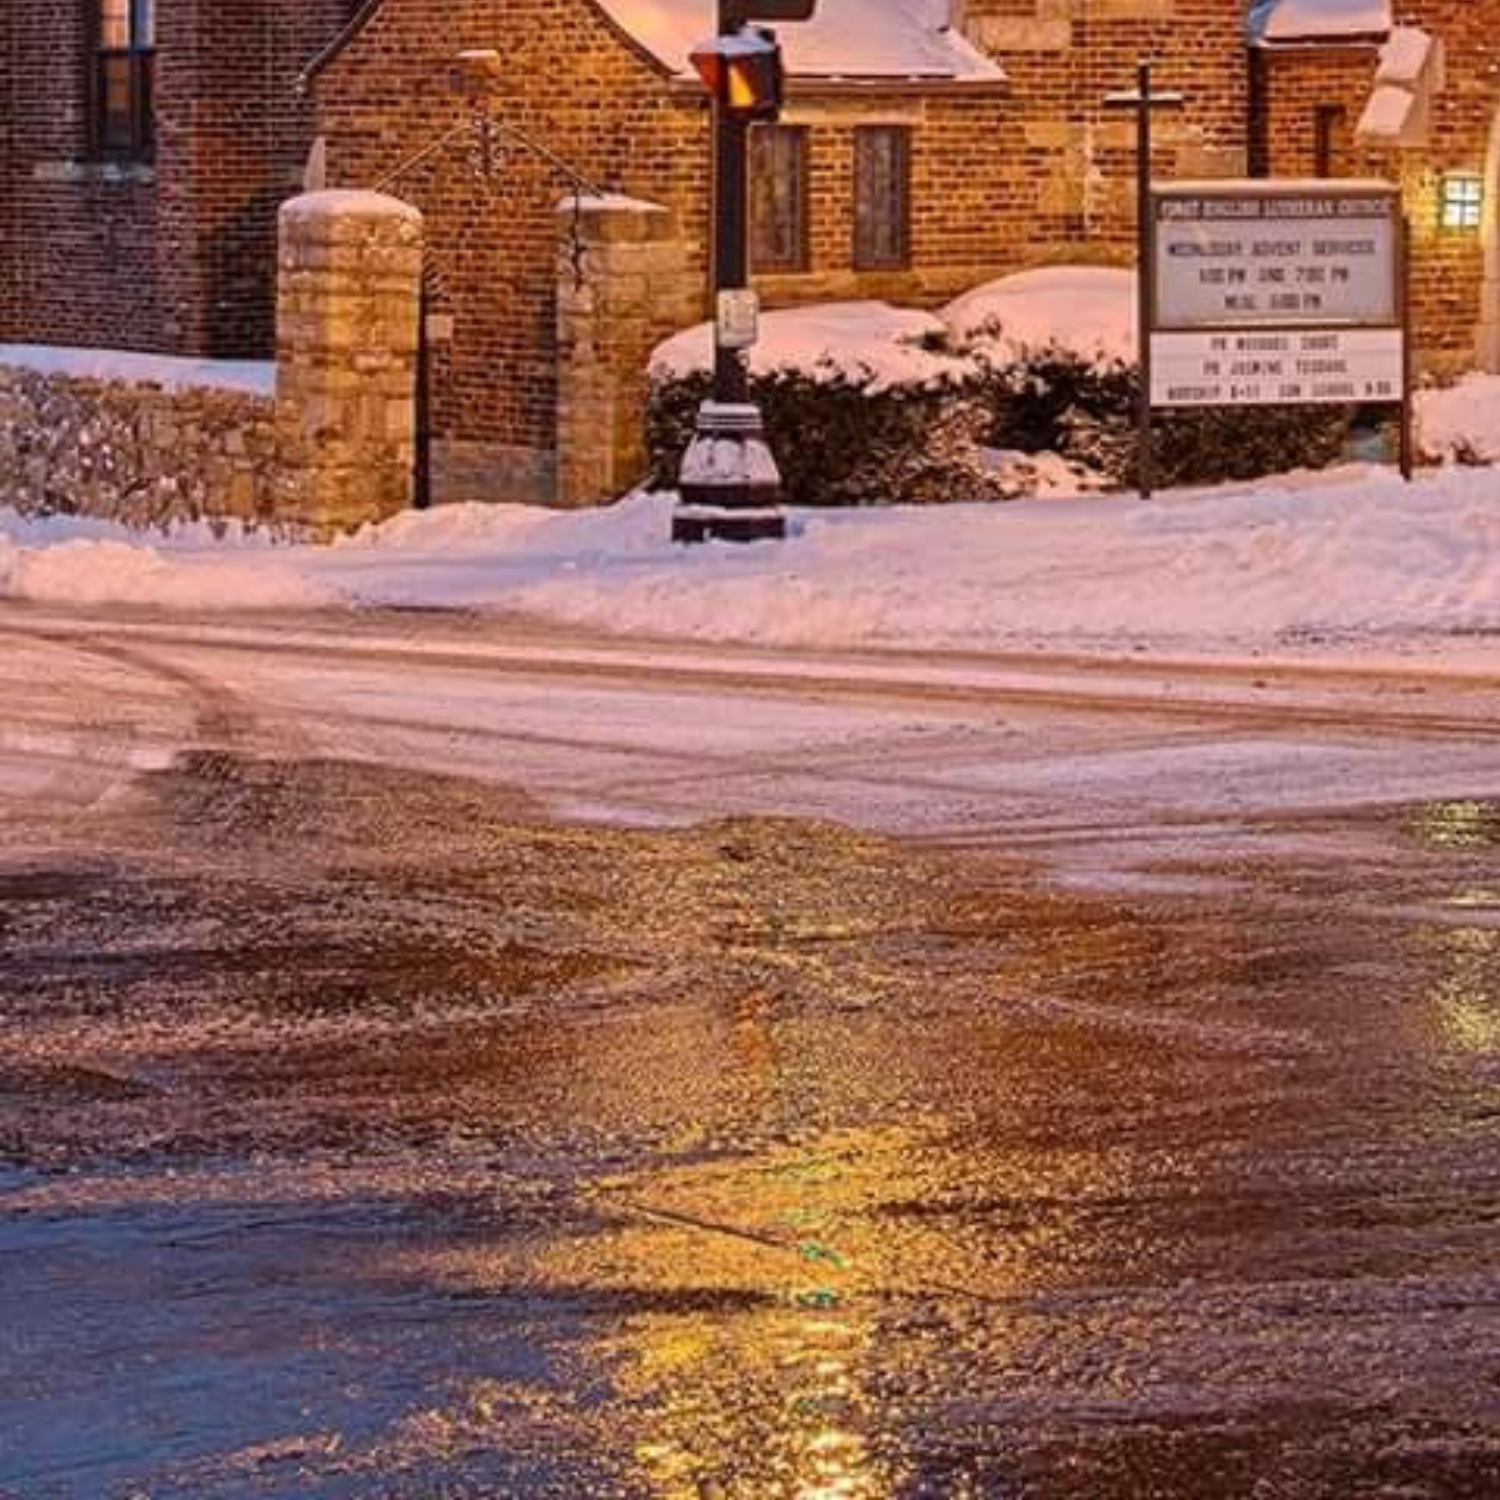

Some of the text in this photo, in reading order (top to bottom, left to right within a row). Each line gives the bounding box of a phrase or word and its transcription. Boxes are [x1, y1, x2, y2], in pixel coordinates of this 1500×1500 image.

[1263, 200, 1334, 217] LUTHERAN
[1252, 240, 1302, 256] ADVENT
[1227, 267, 1246, 284] PM
[1330, 267, 1349, 283] PM
[1302, 293, 1322, 310] PM
